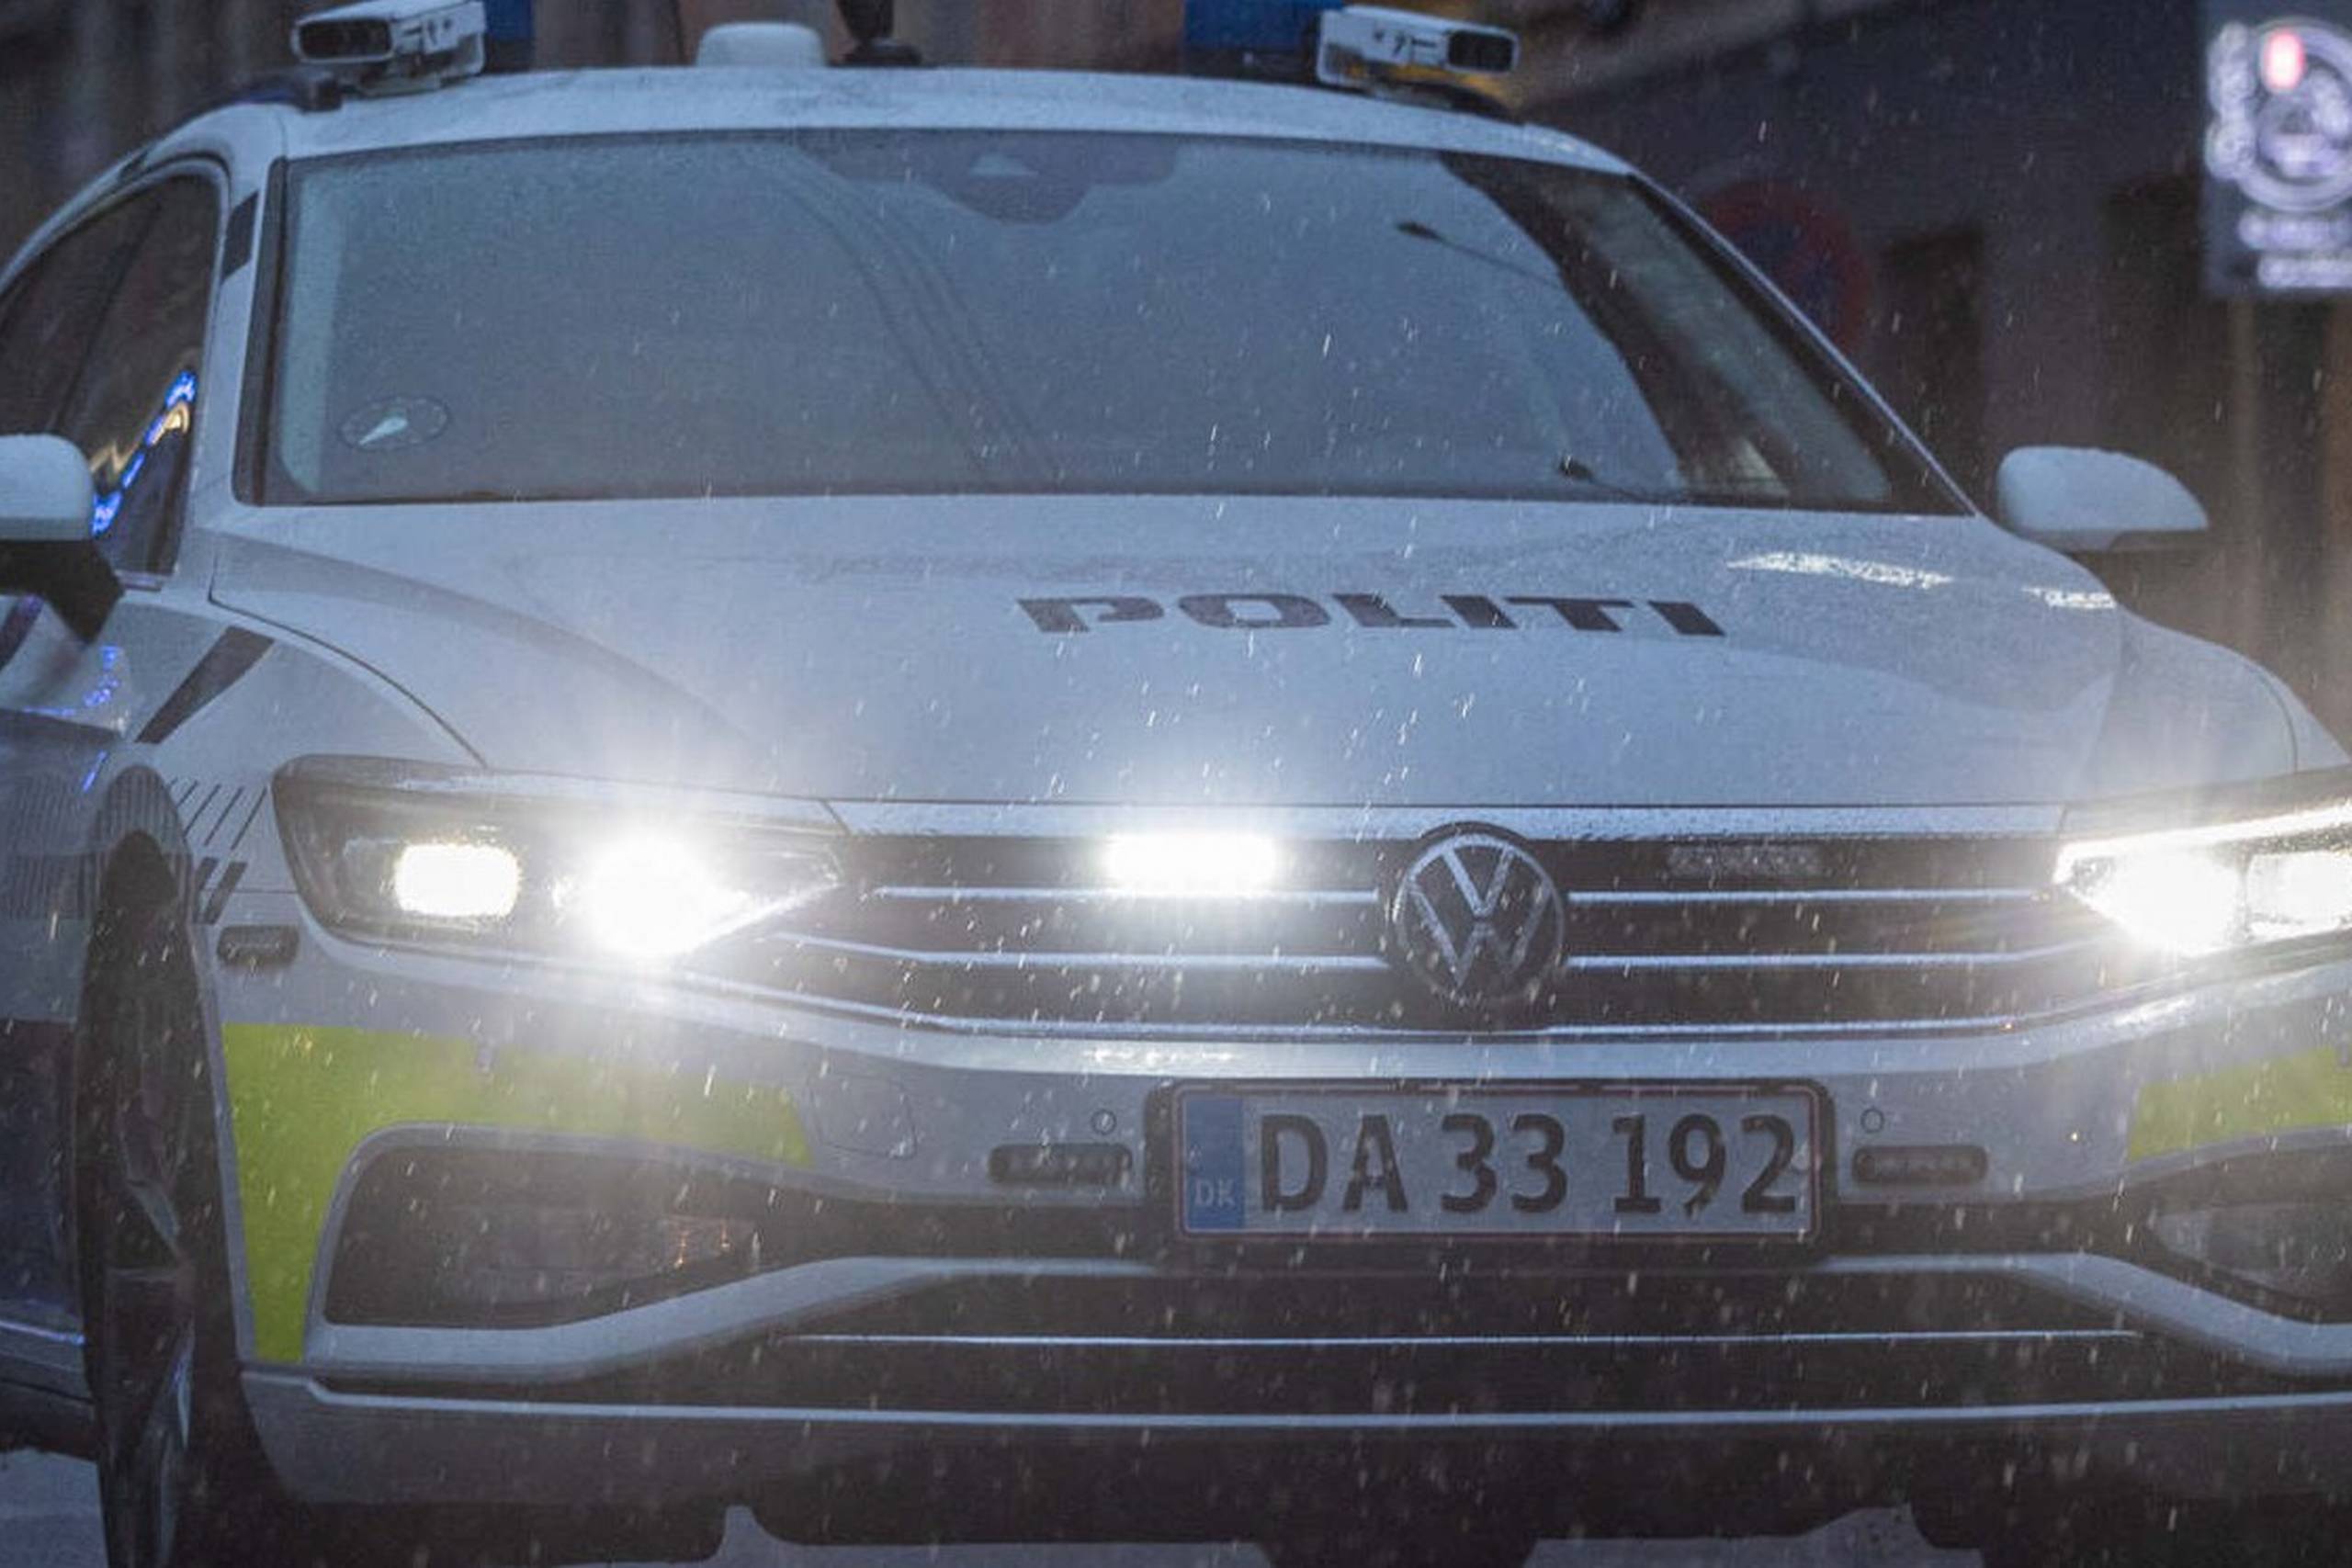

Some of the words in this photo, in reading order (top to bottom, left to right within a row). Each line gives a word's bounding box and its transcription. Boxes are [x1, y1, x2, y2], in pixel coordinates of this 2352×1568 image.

[1015, 592, 1725, 636] POLITI
[1402, 834, 1559, 994] VW
[1194, 1177, 1236, 1209] DK
[1260, 1114, 1408, 1213] DA
[1440, 1114, 1569, 1213] 33
[1611, 1113, 1796, 1213] 192
